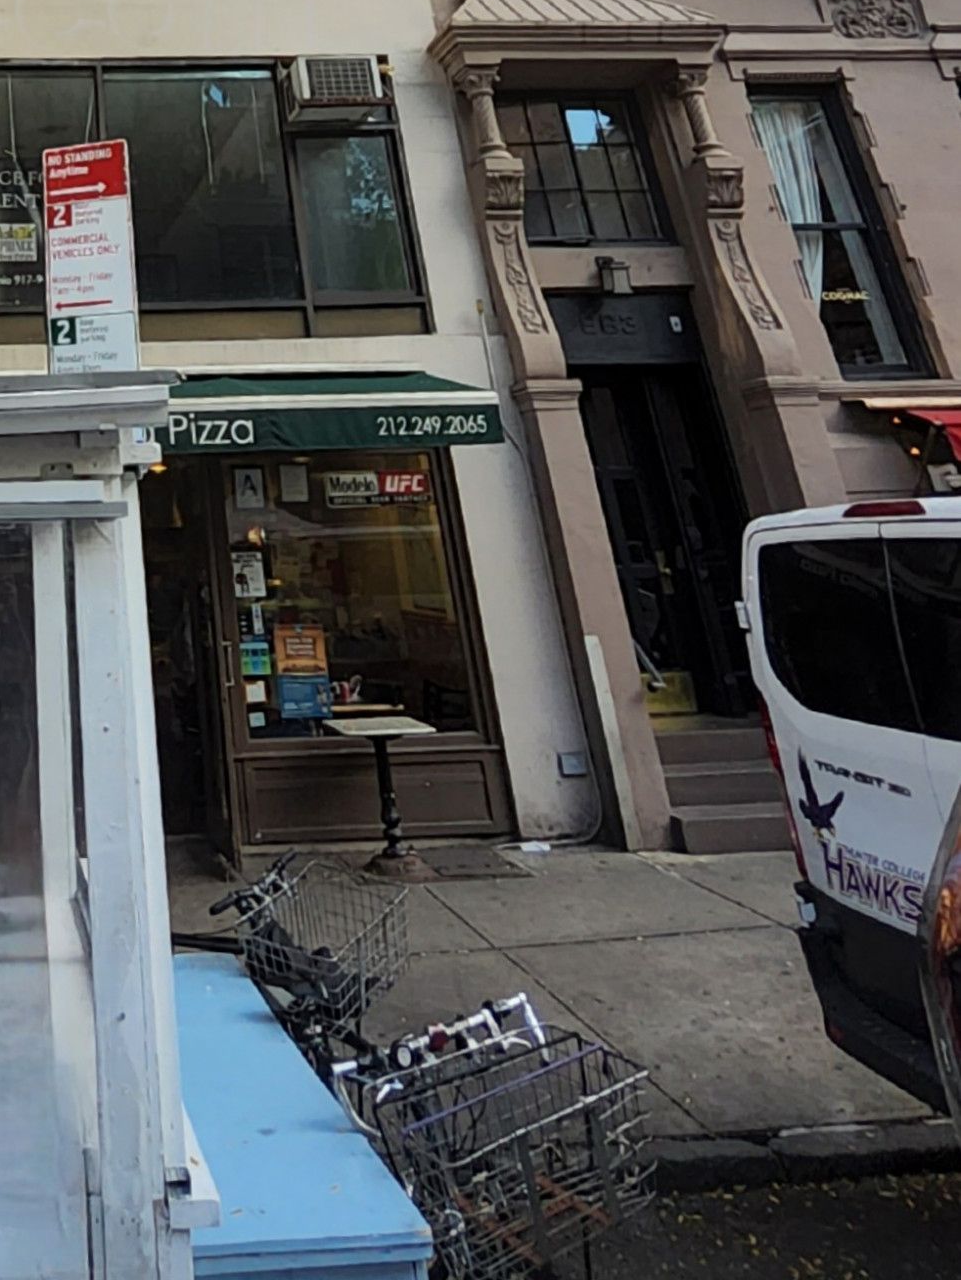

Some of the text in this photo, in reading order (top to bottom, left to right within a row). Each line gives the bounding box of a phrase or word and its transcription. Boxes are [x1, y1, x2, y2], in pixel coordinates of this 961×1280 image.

[48, 147, 113, 166] NO STANDING
[49, 166, 89, 179] Anytime
[54, 205, 67, 226] 2
[51, 233, 109, 247] COMMERCIAL
[52, 244, 120, 259] VEHICLES ONLY
[56, 320, 71, 344] 2
[169, 413, 255, 445] Pizza
[241, 475, 258, 497] A
[329, 474, 425, 493] Modelo UFC
[820, 838, 924, 921] HAWKS
[881, 859, 926, 883] COLLEGE
